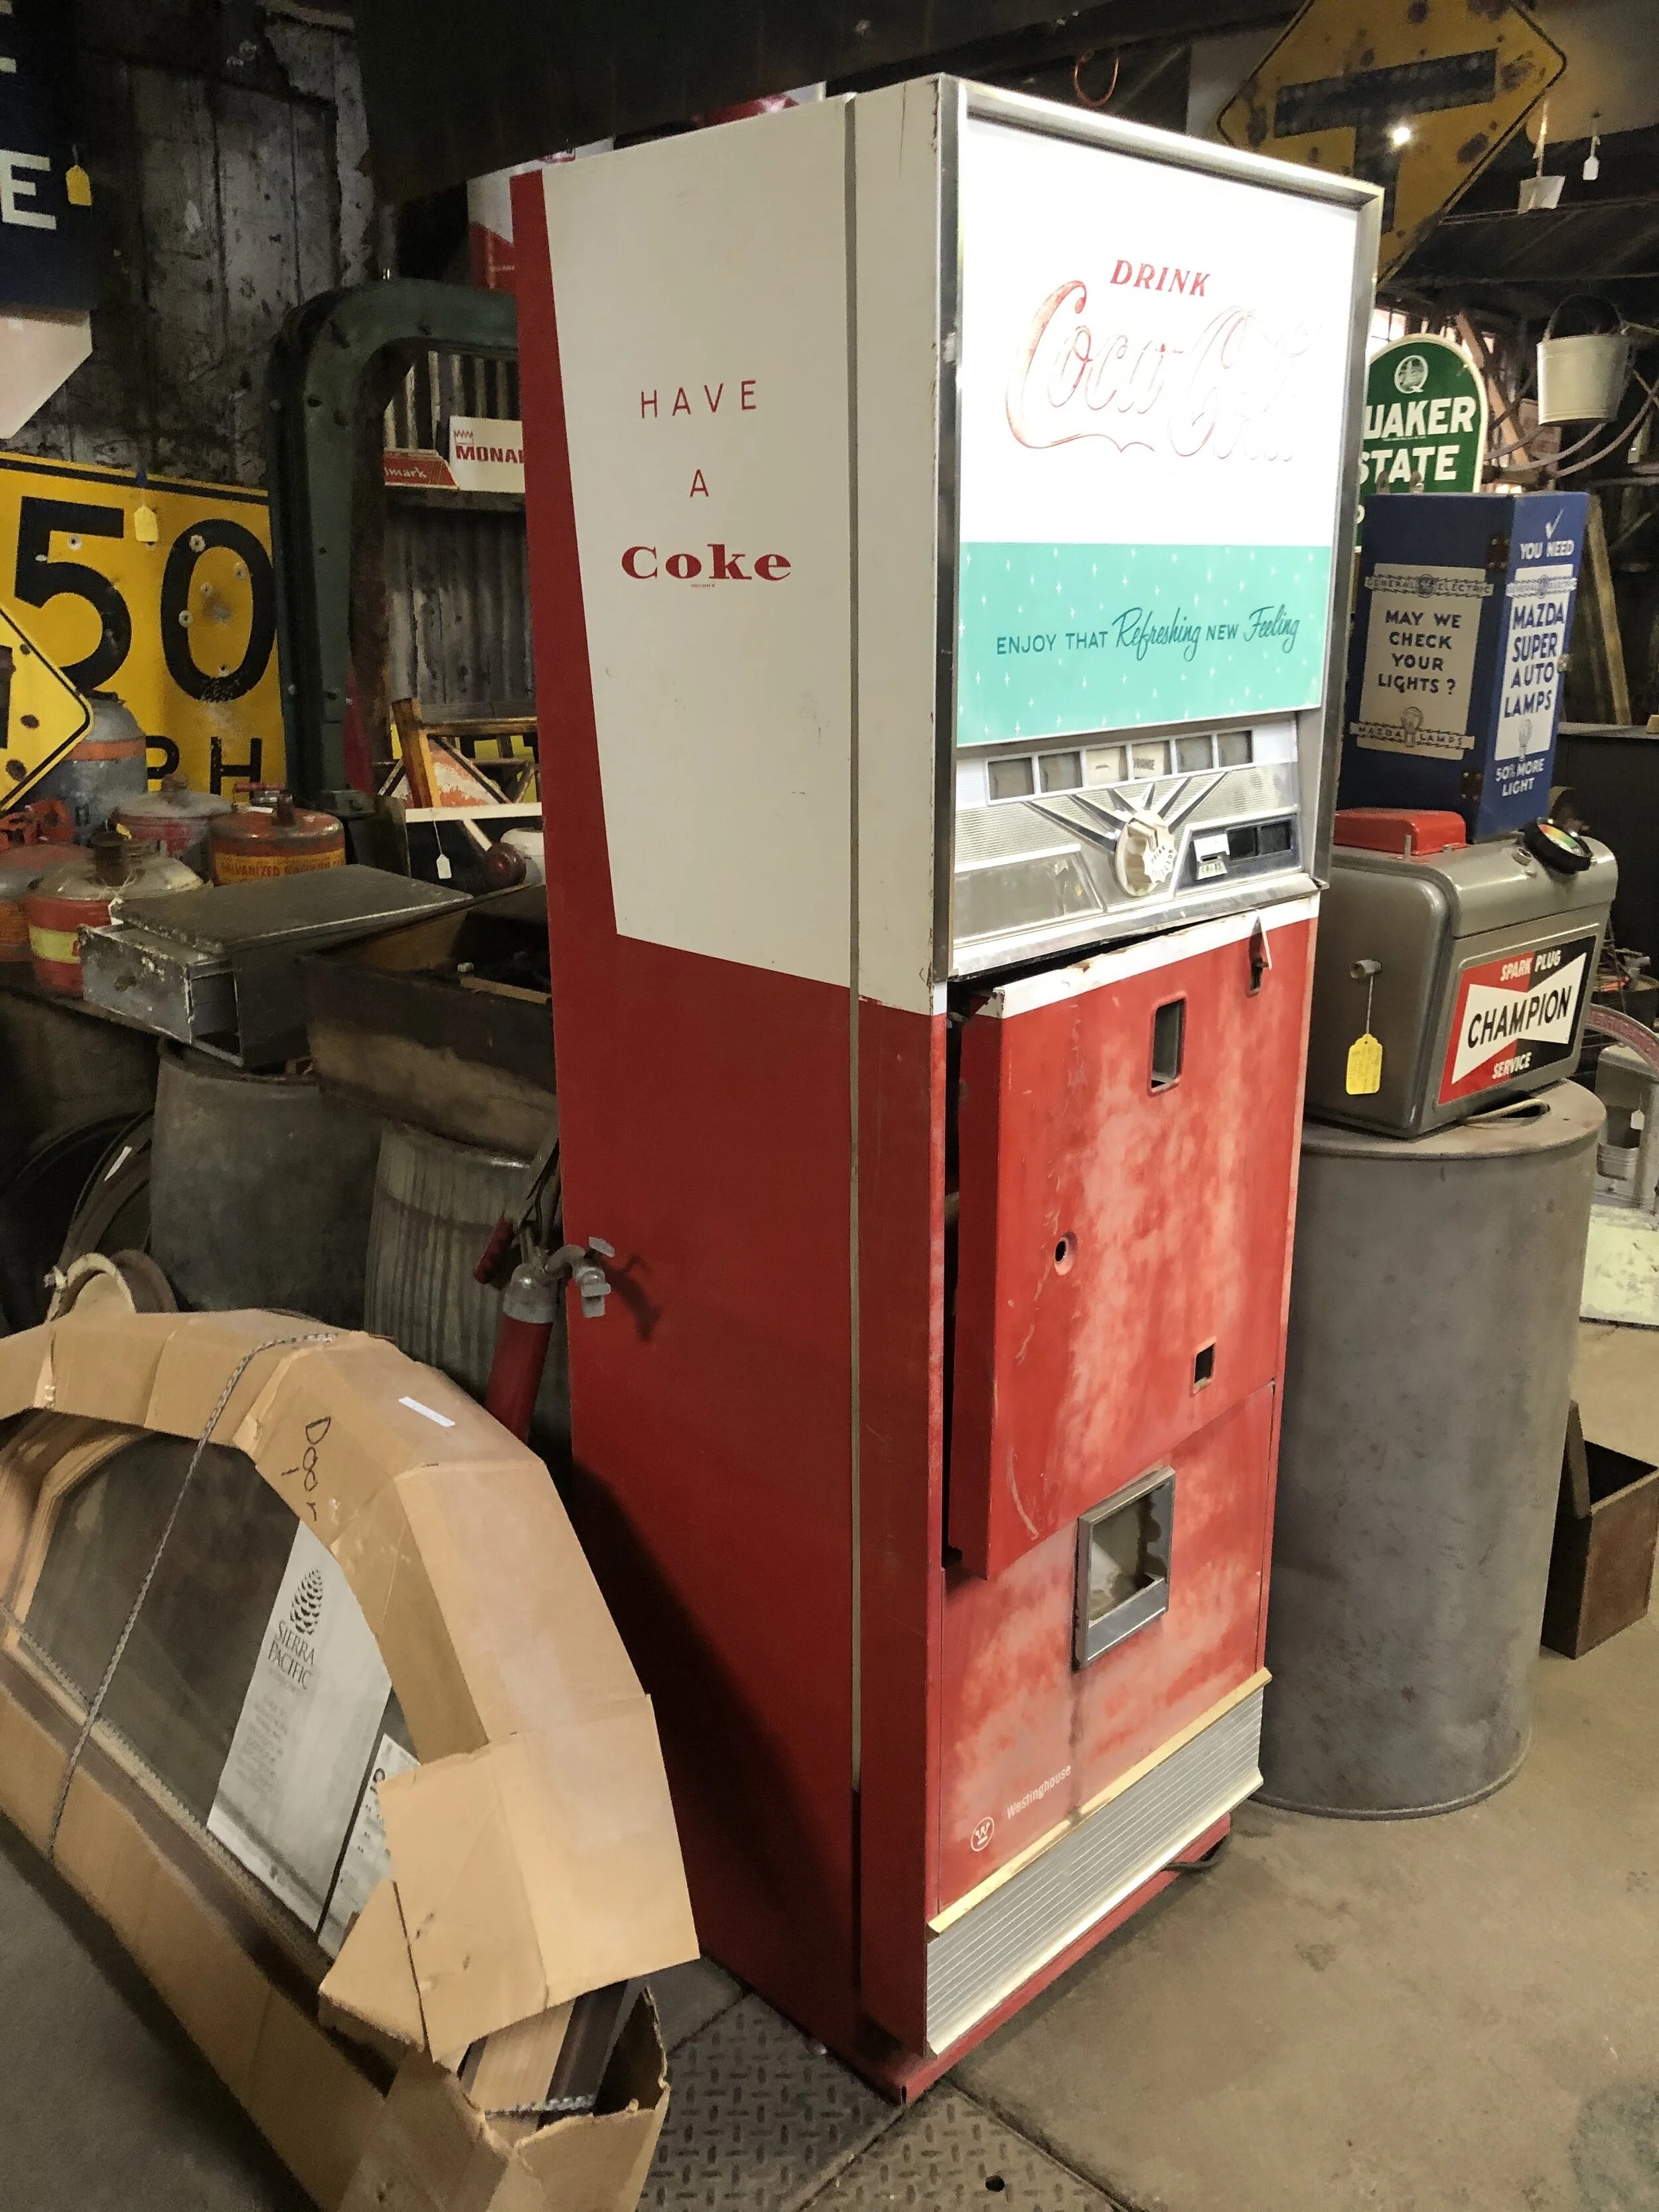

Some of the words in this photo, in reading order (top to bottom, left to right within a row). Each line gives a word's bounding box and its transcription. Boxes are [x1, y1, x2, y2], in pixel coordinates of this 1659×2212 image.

[1110, 259, 1211, 298] DRINK
[640, 379, 757, 419] HAVE
[1364, 396, 1477, 440] UAKER
[456, 445, 524, 464] MONA
[1360, 445, 1461, 485] STATE
[689, 469, 709, 498] A
[621, 543, 791, 581] Coke
[1519, 542, 1544, 559] YOU
[1546, 540, 1575, 557] NEED
[14, 496, 275, 703] 50
[1385, 609, 1425, 626] MAY
[1433, 613, 1462, 629] WE
[1513, 601, 1564, 630] MAZDA
[997, 634, 1057, 655] ENJOY
[1065, 631, 1109, 650] THAT
[1112, 606, 1202, 662] Refreshing
[1206, 623, 1240, 641] NEW
[1243, 603, 1301, 654] Feeling
[1389, 631, 1452, 650] CHECK
[1512, 632, 1558, 662] SUPER
[1391, 652, 1443, 671] YOUR
[1510, 661, 1554, 689] AUTO
[1504, 689, 1553, 718] LAMPS
[1358, 726, 1403, 738] MAZDA
[1419, 733, 1463, 746] LAMPS
[145, 735, 262, 798] PH
[1516, 758, 1546, 776] MORE
[1502, 777, 1536, 797] LIGHT
[1500, 957, 1534, 982] SPARK
[1534, 950, 1561, 973] PLUG
[1467, 985, 1572, 1049] CHAMPION
[1492, 1051, 1532, 1080] SERVICE
[274, 1619, 315, 1666] SIERRA
[267, 1639, 312, 1690] PACIFIC
[1006, 1765, 1072, 1820] Westinghouse
